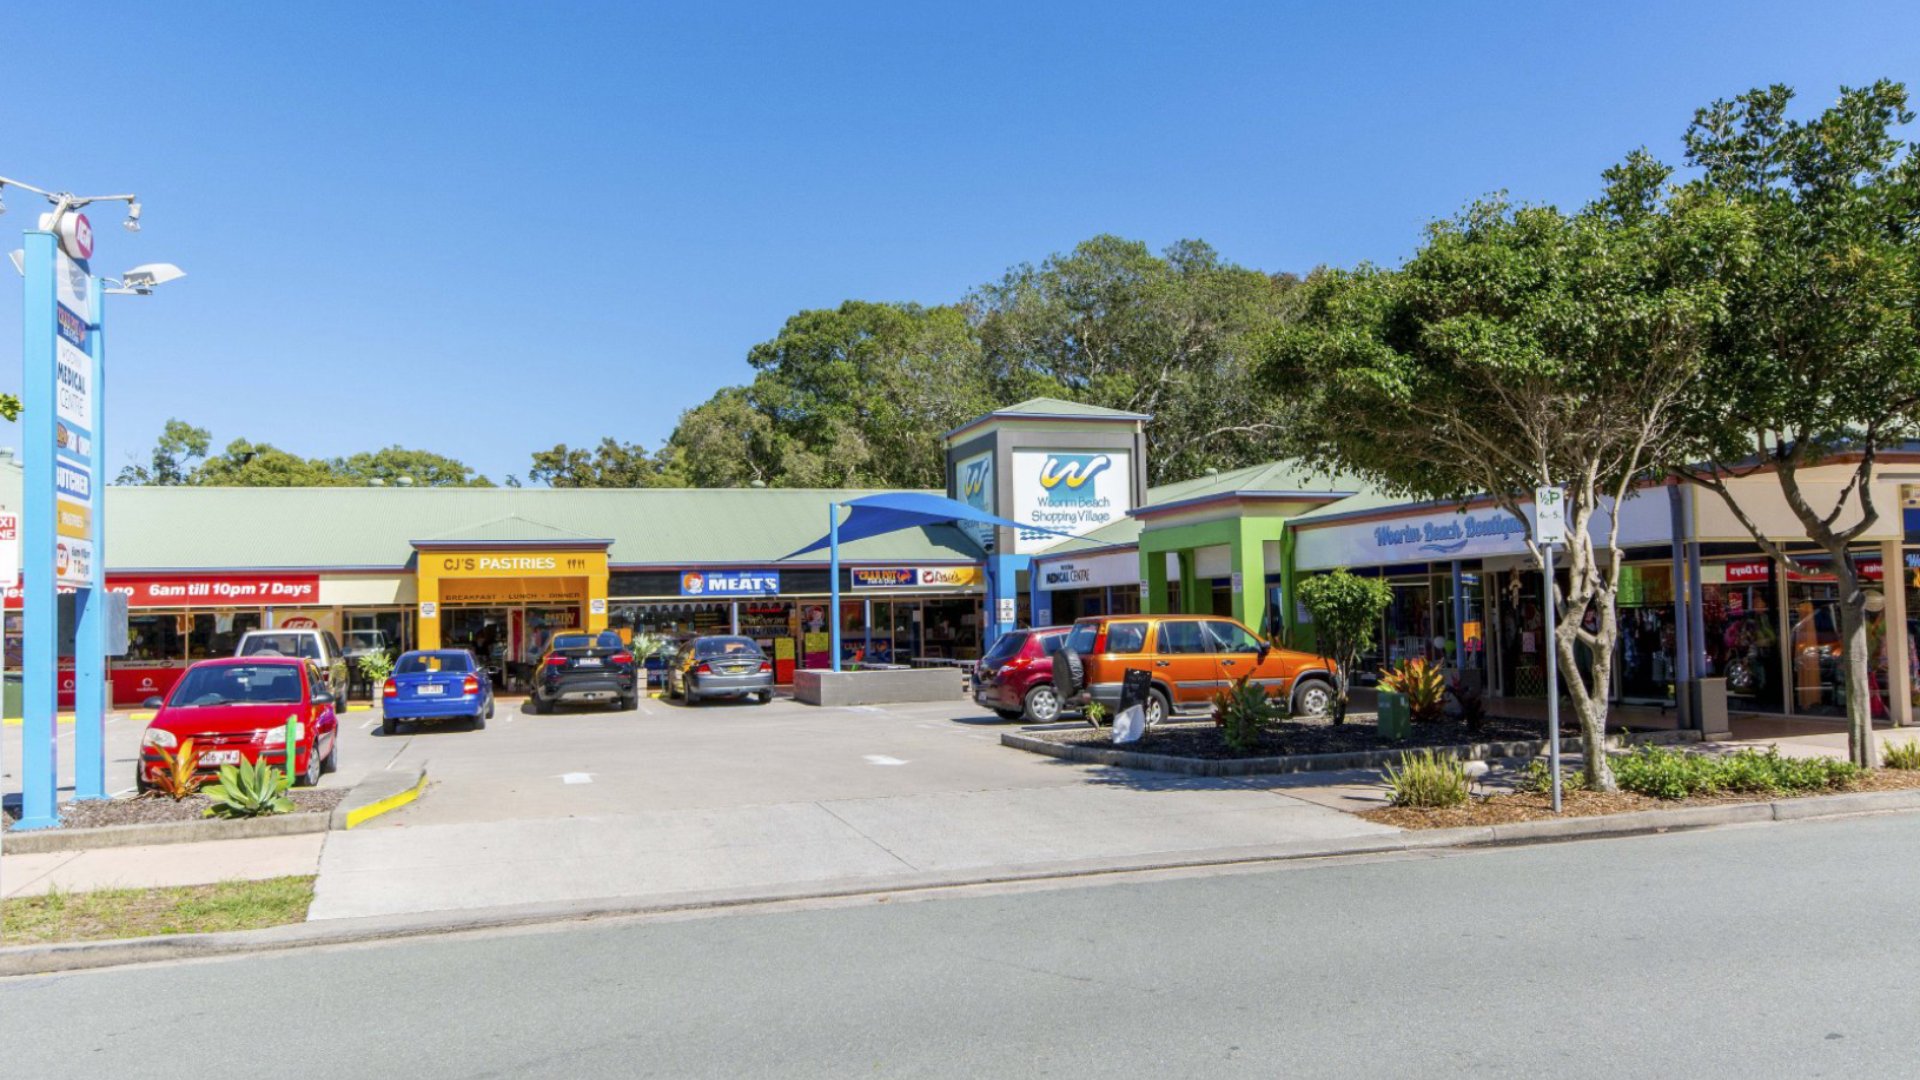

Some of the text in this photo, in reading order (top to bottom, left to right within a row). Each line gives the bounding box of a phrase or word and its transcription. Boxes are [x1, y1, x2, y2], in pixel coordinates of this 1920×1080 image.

[57, 361, 86, 395] MEDICAL
[1037, 496, 1111, 508] Woorim Beach
[1031, 510, 1111, 524] Shopping Village
[1375, 525, 1423, 546] Woorim
[1424, 520, 1463, 542] Beach
[444, 557, 556, 571] CJ'S PASTRIES
[1070, 569, 1090, 581] CENTRE
[149, 584, 185, 596] 6am
[188, 583, 209, 595] till
[212, 583, 256, 597] 10pm
[259, 583, 269, 594] 7
[271, 583, 312, 596] Days
[708, 578, 778, 591] MEATS
[549, 591, 581, 599] DINNER
